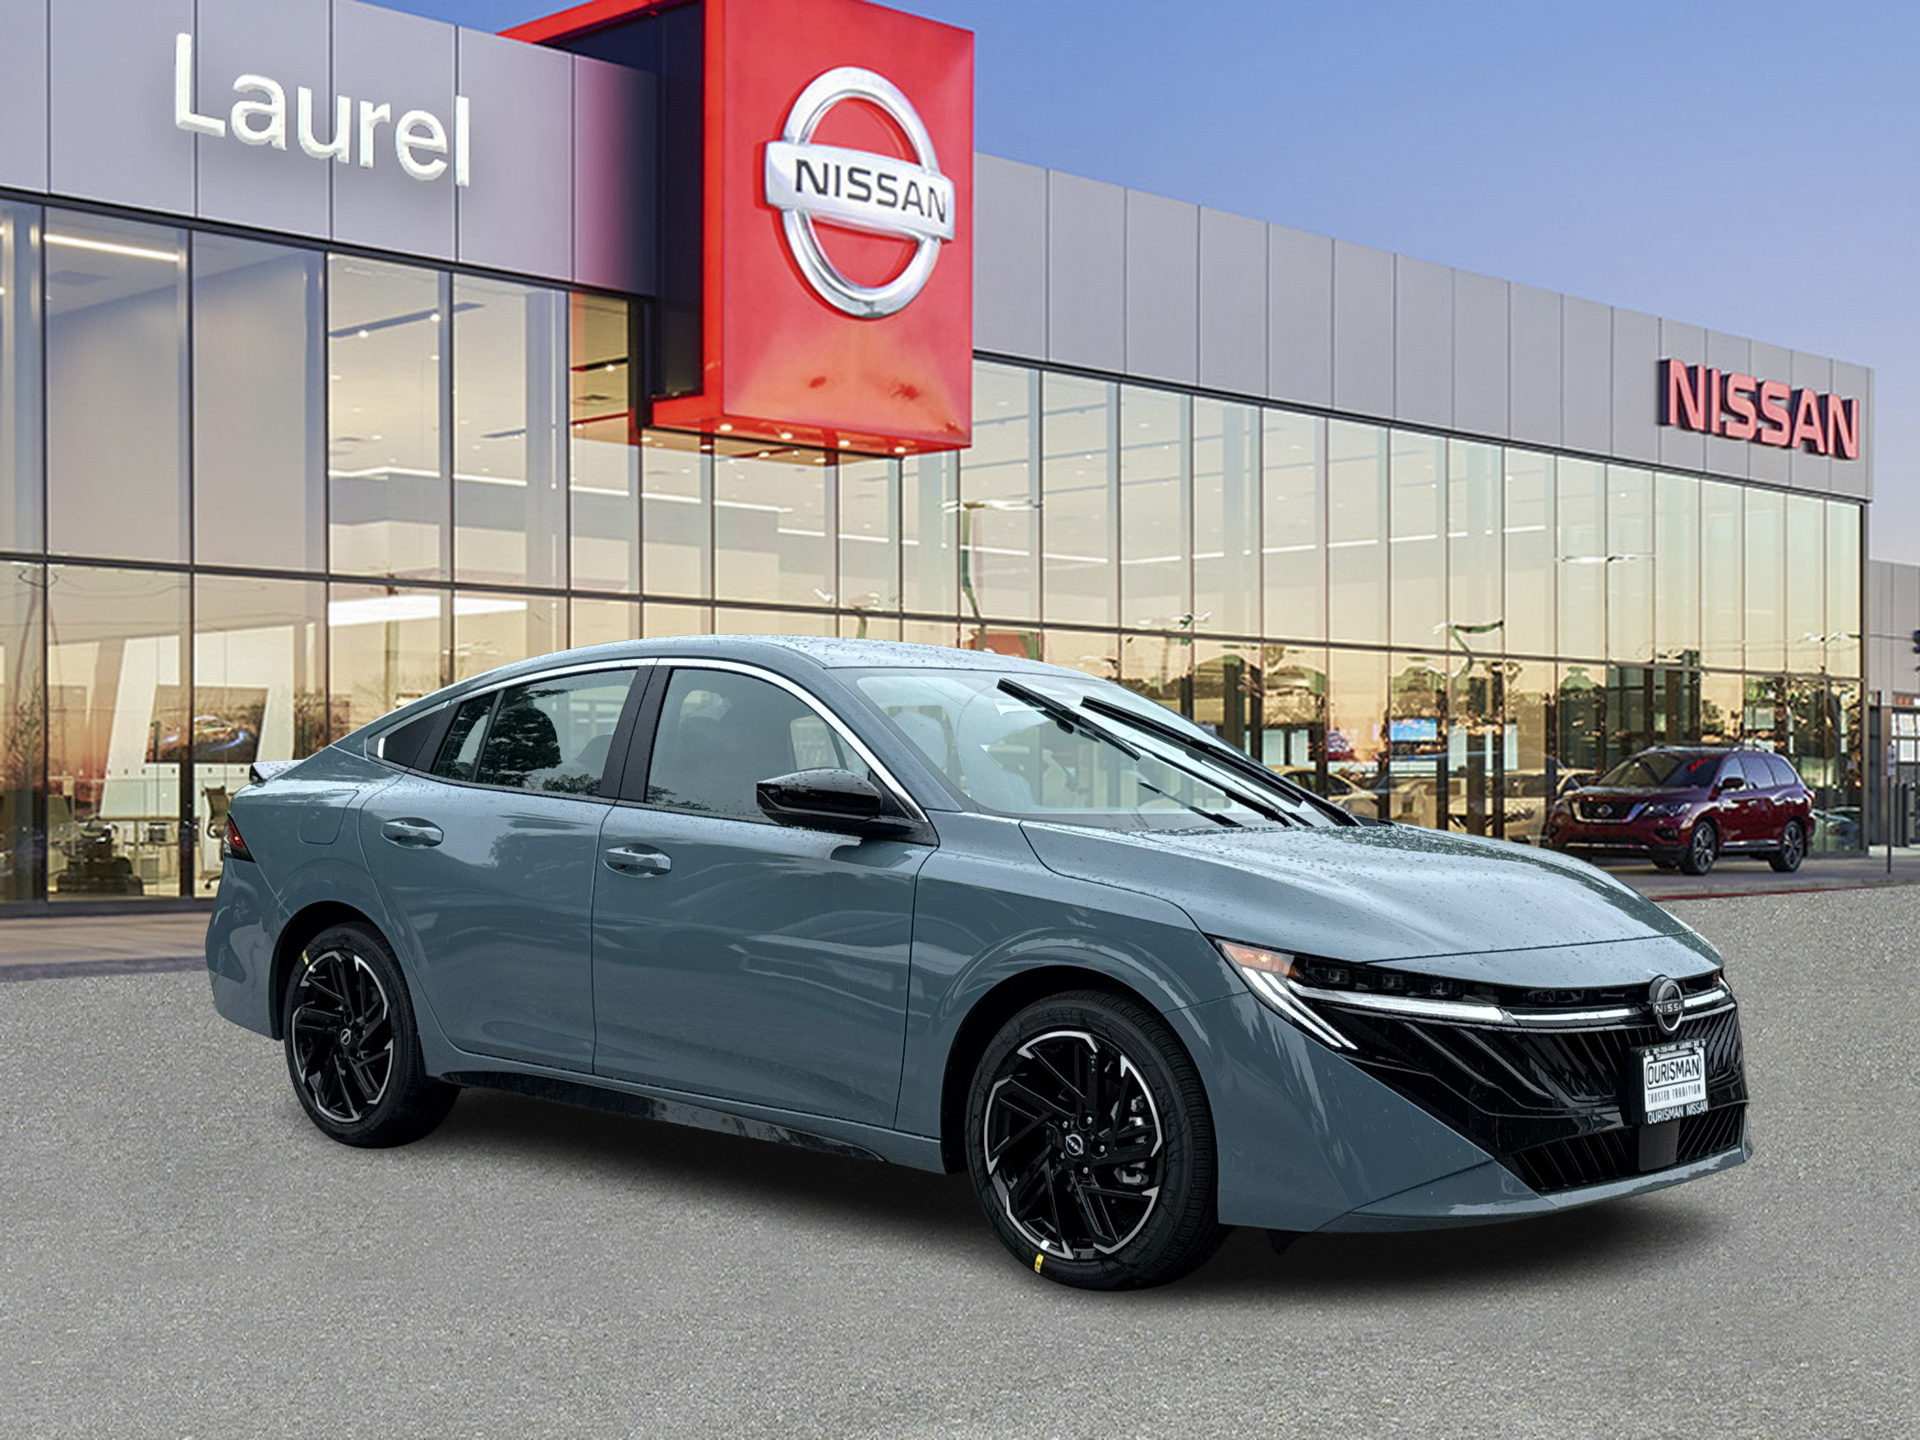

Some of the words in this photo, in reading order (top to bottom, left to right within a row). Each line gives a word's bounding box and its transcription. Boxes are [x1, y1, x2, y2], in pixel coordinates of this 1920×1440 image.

[175, 33, 469, 187] Laurel
[795, 159, 946, 224] NISSAN
[1659, 359, 1859, 459] NISSAN
[1655, 1003, 1682, 1013] NISSA
[1648, 1058, 1700, 1085] OURISMAN
[1672, 1084, 1701, 1099] TRADITION
[1647, 1104, 1684, 1124] OURISMAN
[1687, 1100, 1708, 1115] NISSAN
